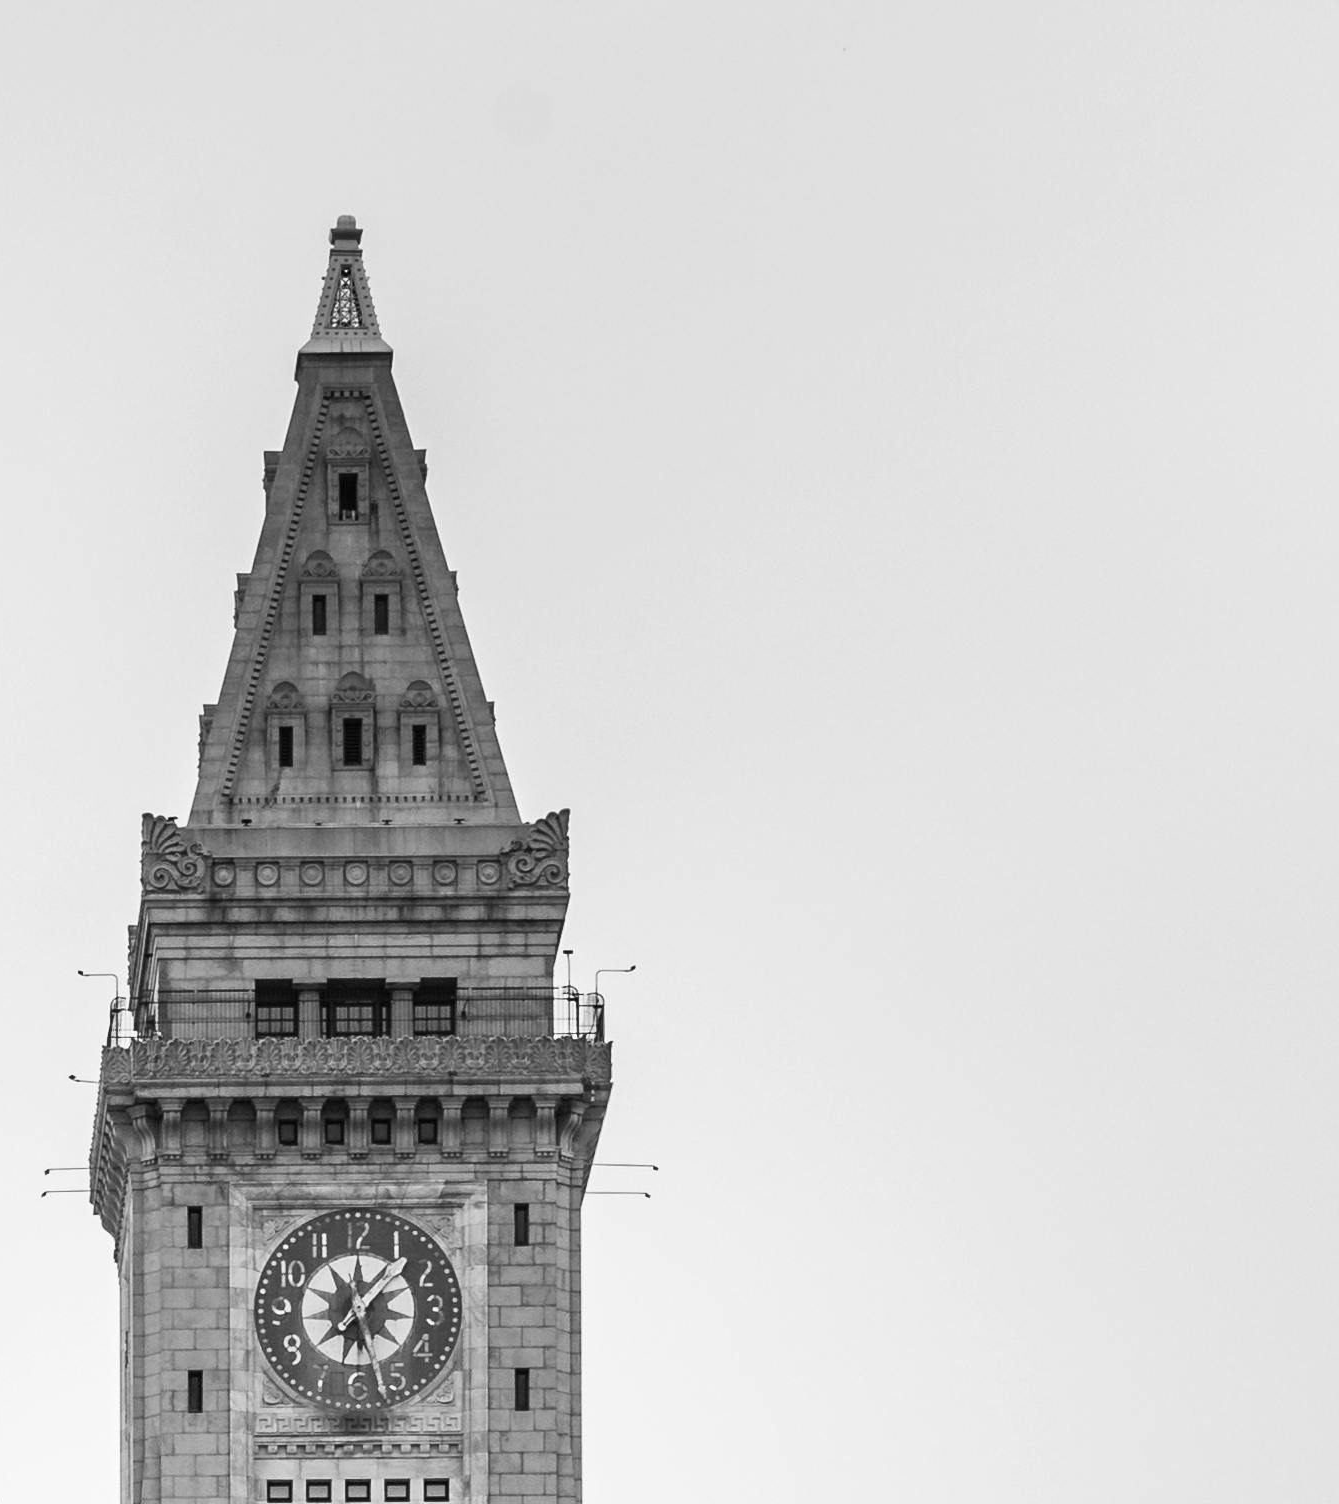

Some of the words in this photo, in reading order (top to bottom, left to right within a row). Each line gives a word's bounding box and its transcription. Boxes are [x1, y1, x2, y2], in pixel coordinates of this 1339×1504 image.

[312, 1232, 328, 1258] 11
[347, 1222, 371, 1249] 12
[280, 1260, 306, 1287] 10
[418, 1259, 434, 1287] 2
[272, 1297, 292, 1326] 9
[426, 1295, 444, 1326] 3
[413, 1333, 433, 1363] 4
[312, 1364, 329, 1392] 7
[347, 1372, 368, 1400] 6
[389, 1362, 407, 1391] 5
